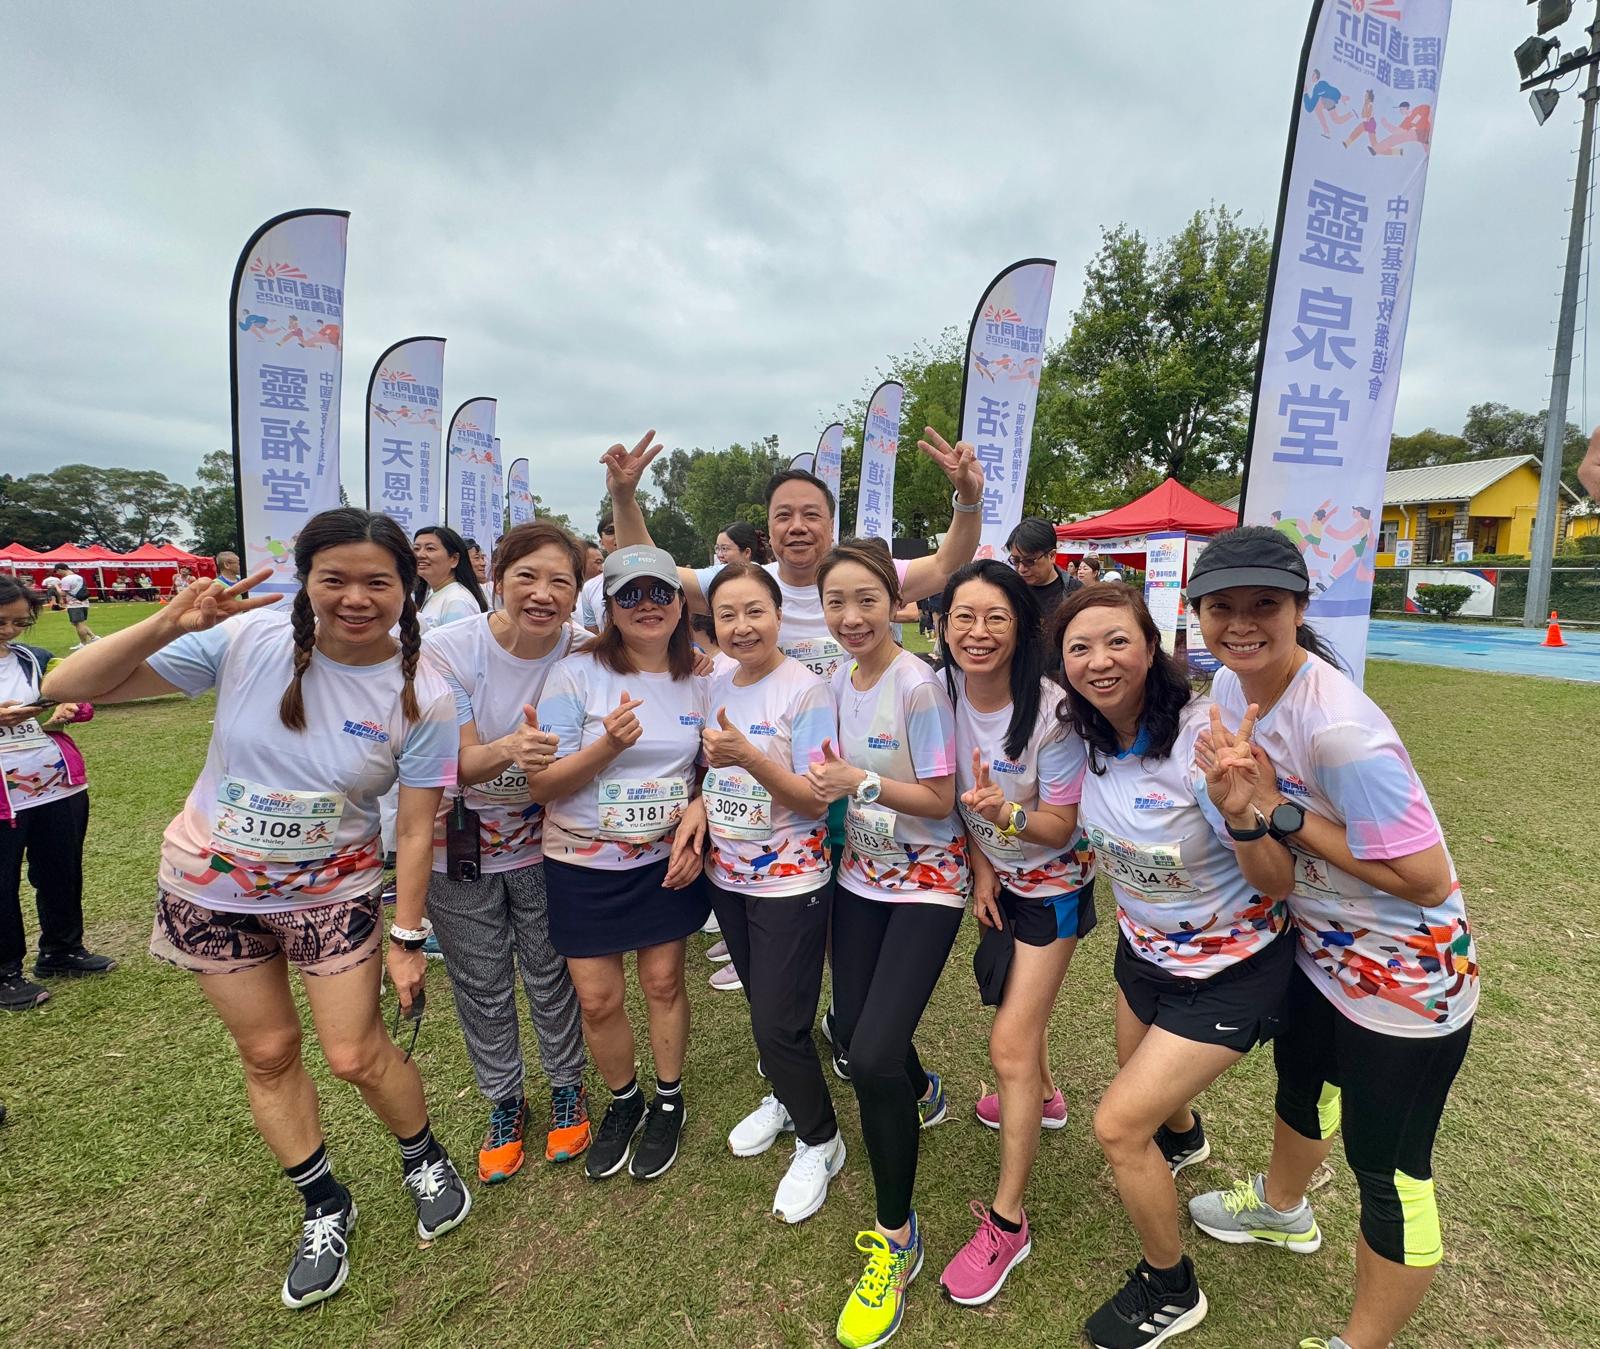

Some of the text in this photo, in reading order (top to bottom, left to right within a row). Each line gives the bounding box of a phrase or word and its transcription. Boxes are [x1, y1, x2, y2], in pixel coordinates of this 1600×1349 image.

[625, 806, 664, 822] 3181
[715, 799, 748, 817] 3029
[241, 816, 302, 838] 3108
[850, 828, 878, 848] 3183
[1116, 860, 1161, 884] 3134
